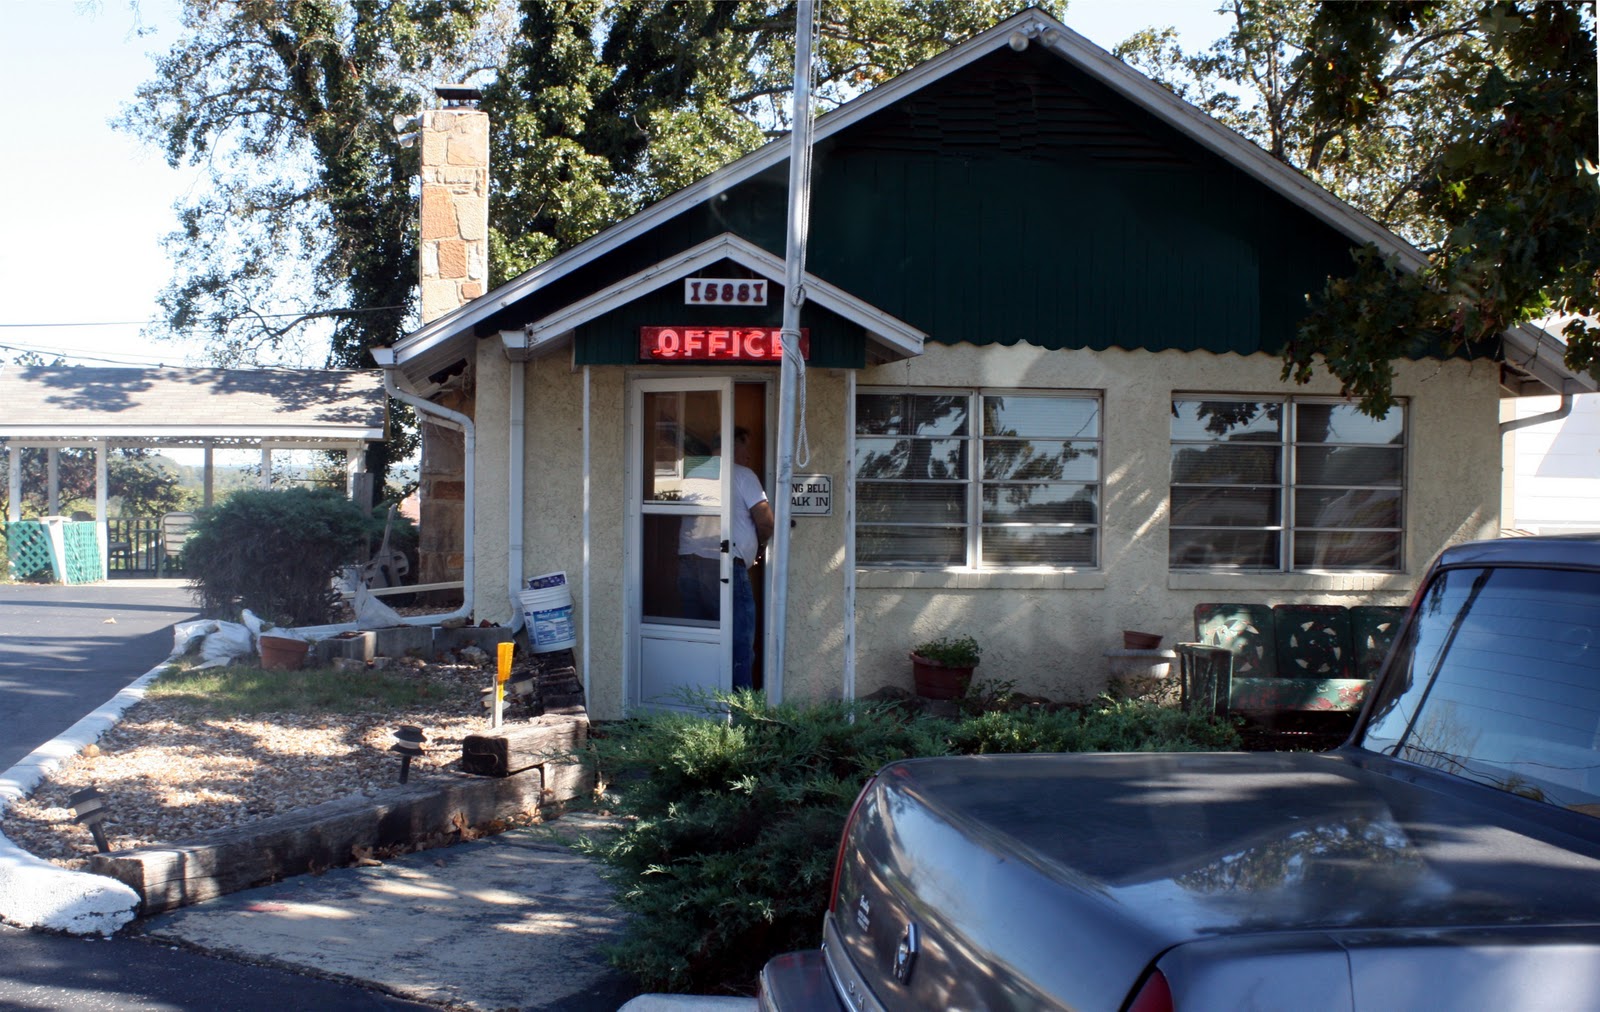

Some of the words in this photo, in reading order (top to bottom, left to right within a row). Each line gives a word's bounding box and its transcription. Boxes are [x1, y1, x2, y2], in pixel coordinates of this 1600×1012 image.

[691, 282, 764, 302] 15881
[791, 483, 804, 493] NG
[807, 483, 829, 493] BELL
[791, 496, 810, 507] ALK
[815, 496, 829, 507] IN
